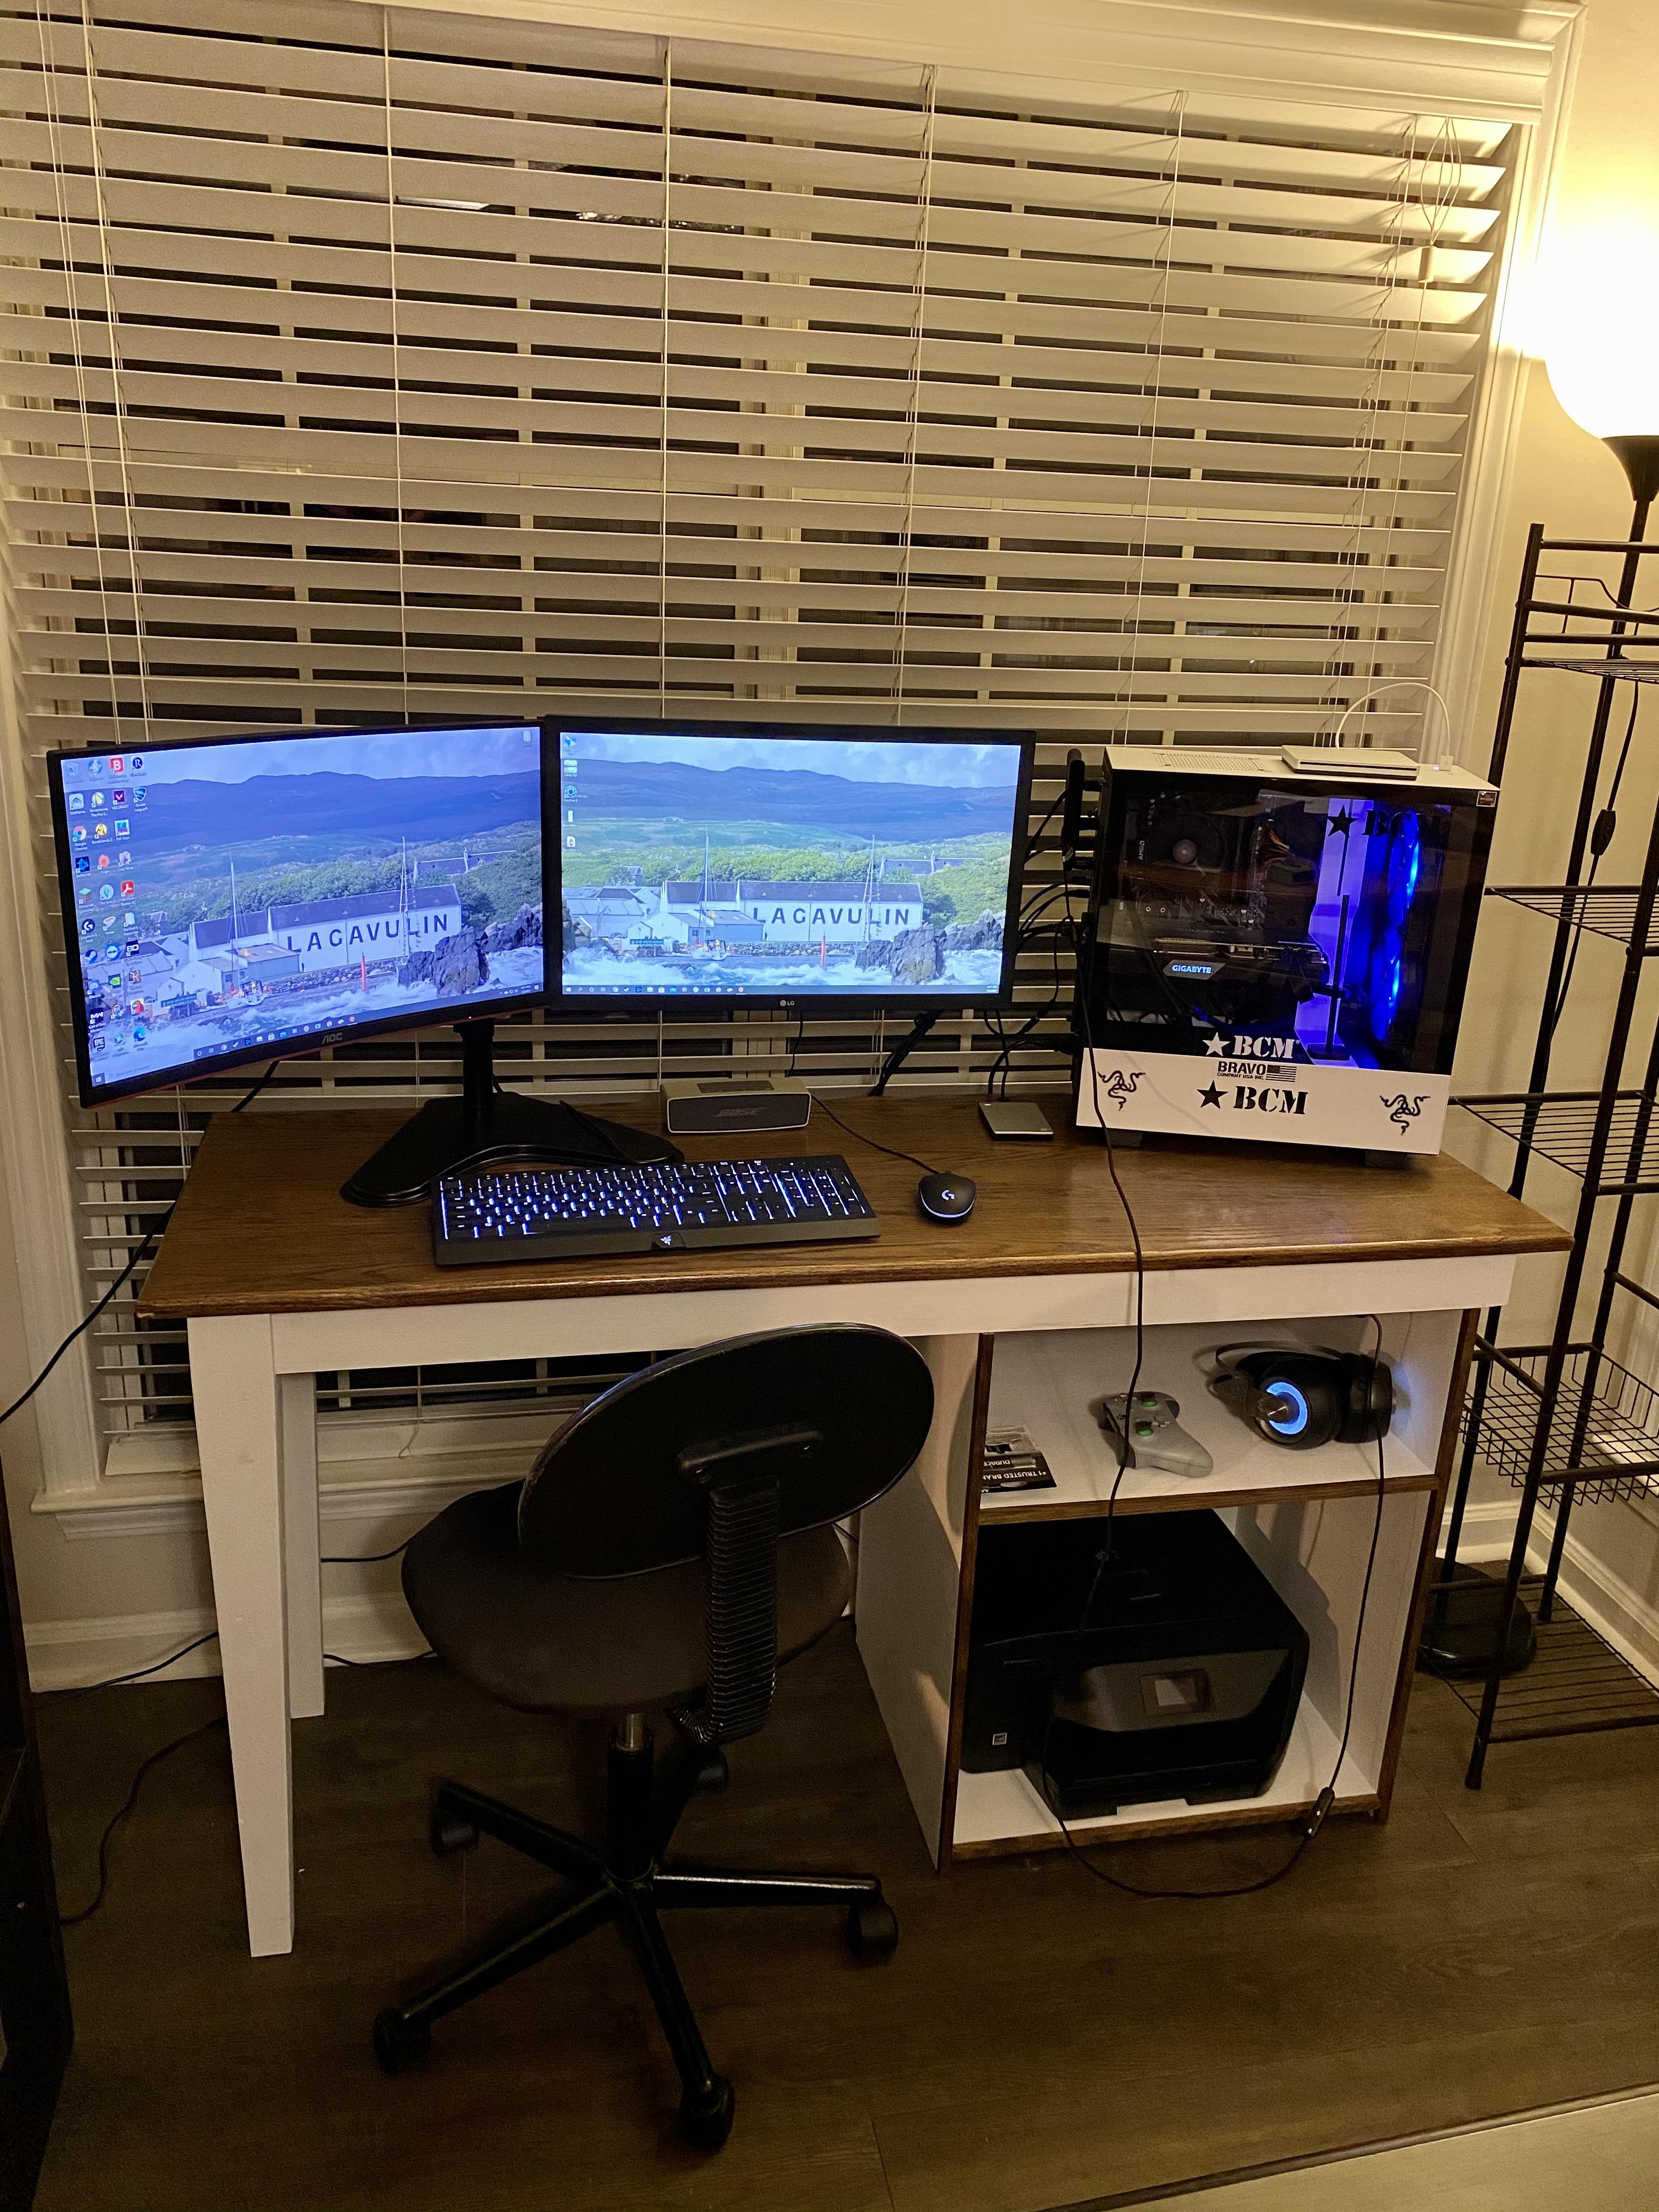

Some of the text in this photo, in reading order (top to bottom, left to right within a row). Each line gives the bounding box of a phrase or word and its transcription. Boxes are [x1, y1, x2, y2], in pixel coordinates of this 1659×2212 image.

[1363, 809, 1440, 840] BC
[753, 907, 909, 925] LAGAVULIN
[287, 914, 447, 953] LAGAVULIN
[1172, 964, 1212, 974] GIGABYTE
[321, 1032, 343, 1045] AOC
[1218, 1061, 1266, 1075] BRAVO
[1233, 1086, 1308, 1115] BCM
[713, 1107, 766, 1117] BOSE
[1003, 1471, 1038, 1479] TRUSTED
